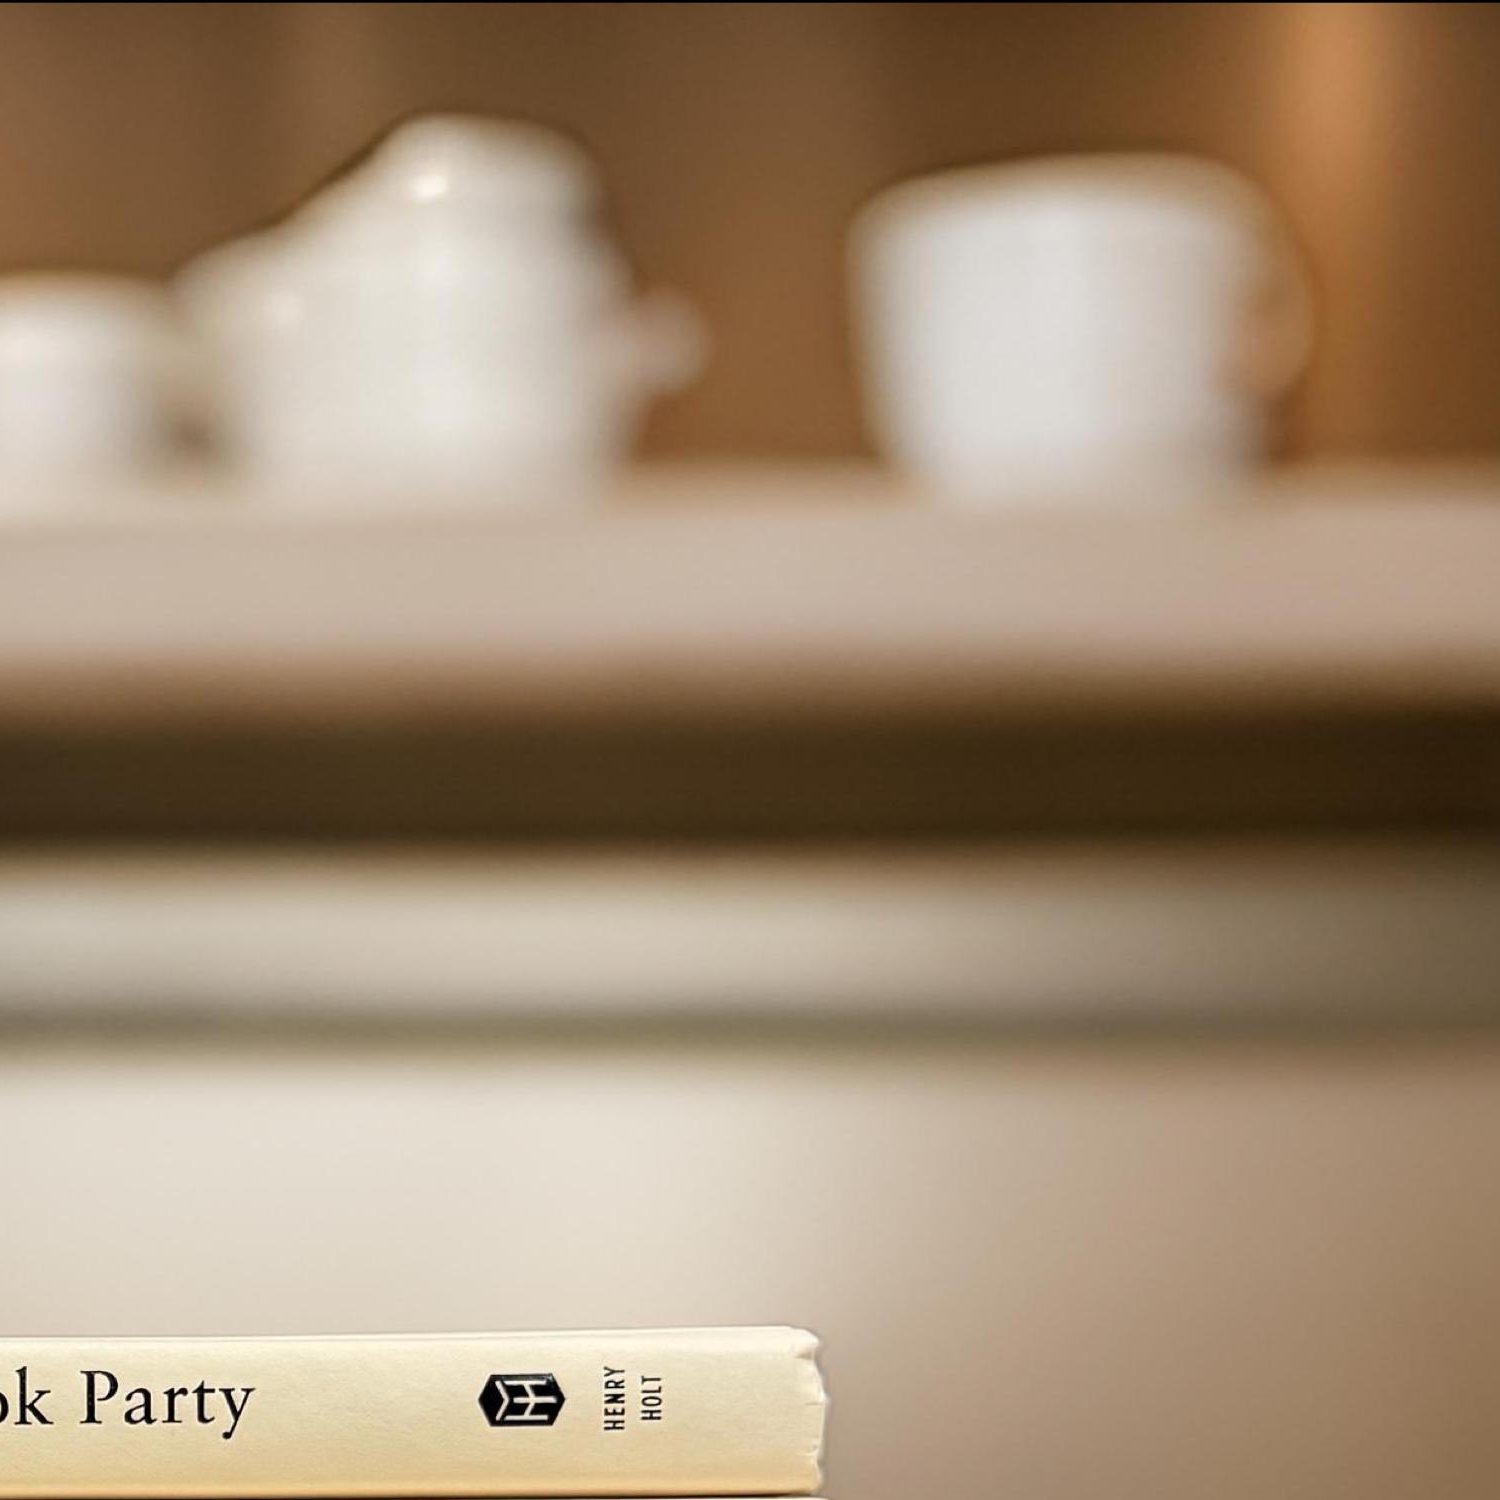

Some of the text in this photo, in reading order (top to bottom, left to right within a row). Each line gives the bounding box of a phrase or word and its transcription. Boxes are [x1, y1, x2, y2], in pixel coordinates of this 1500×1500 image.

[79, 1370, 256, 1440] Party
[603, 1366, 626, 1431] HENRY
[641, 1375, 662, 1421] HOLT
